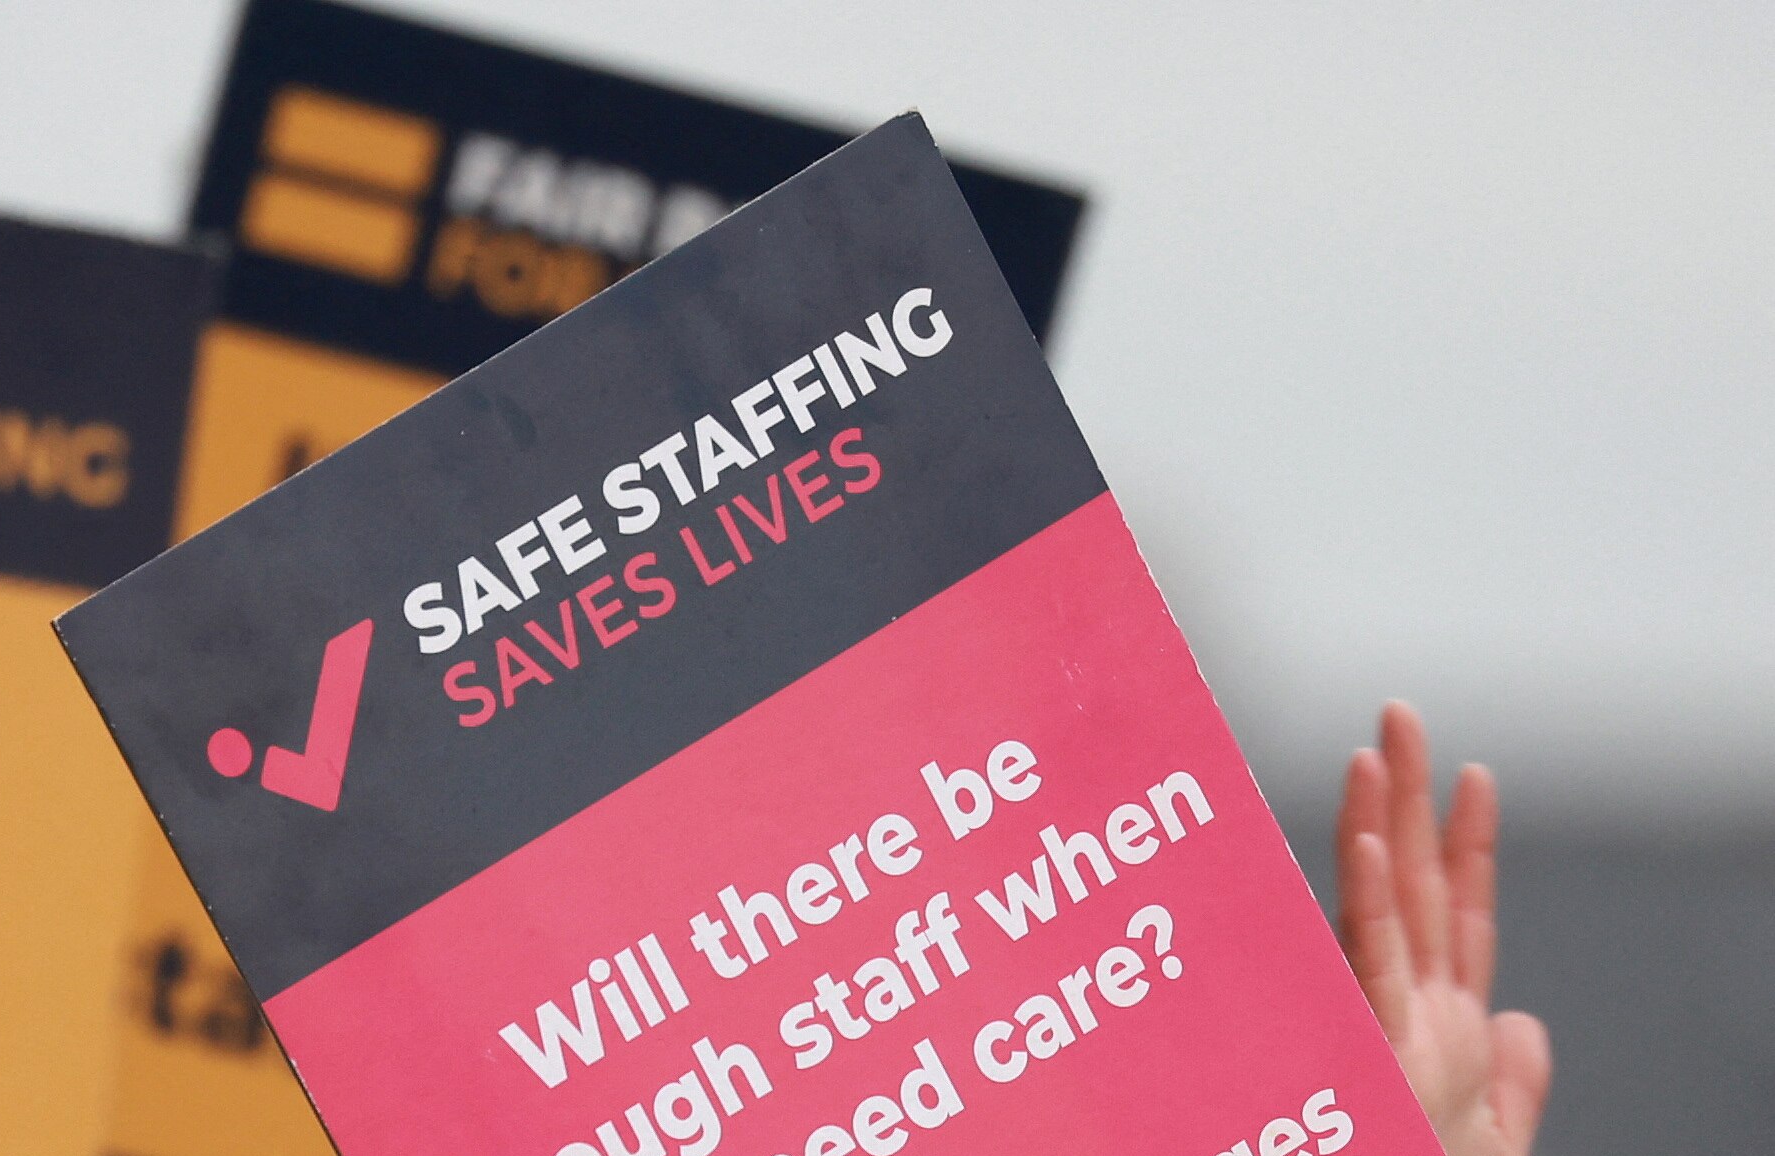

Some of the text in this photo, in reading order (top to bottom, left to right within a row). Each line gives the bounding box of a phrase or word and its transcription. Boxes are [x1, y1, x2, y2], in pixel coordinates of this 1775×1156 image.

[403, 288, 953, 654] SAFE STAFFING
[443, 427, 882, 727] SAVES LIVES
[498, 740, 1042, 1088] Will there be
[779, 892, 970, 1068] staff
[975, 771, 1215, 941] when
[974, 904, 1184, 1082] care?
